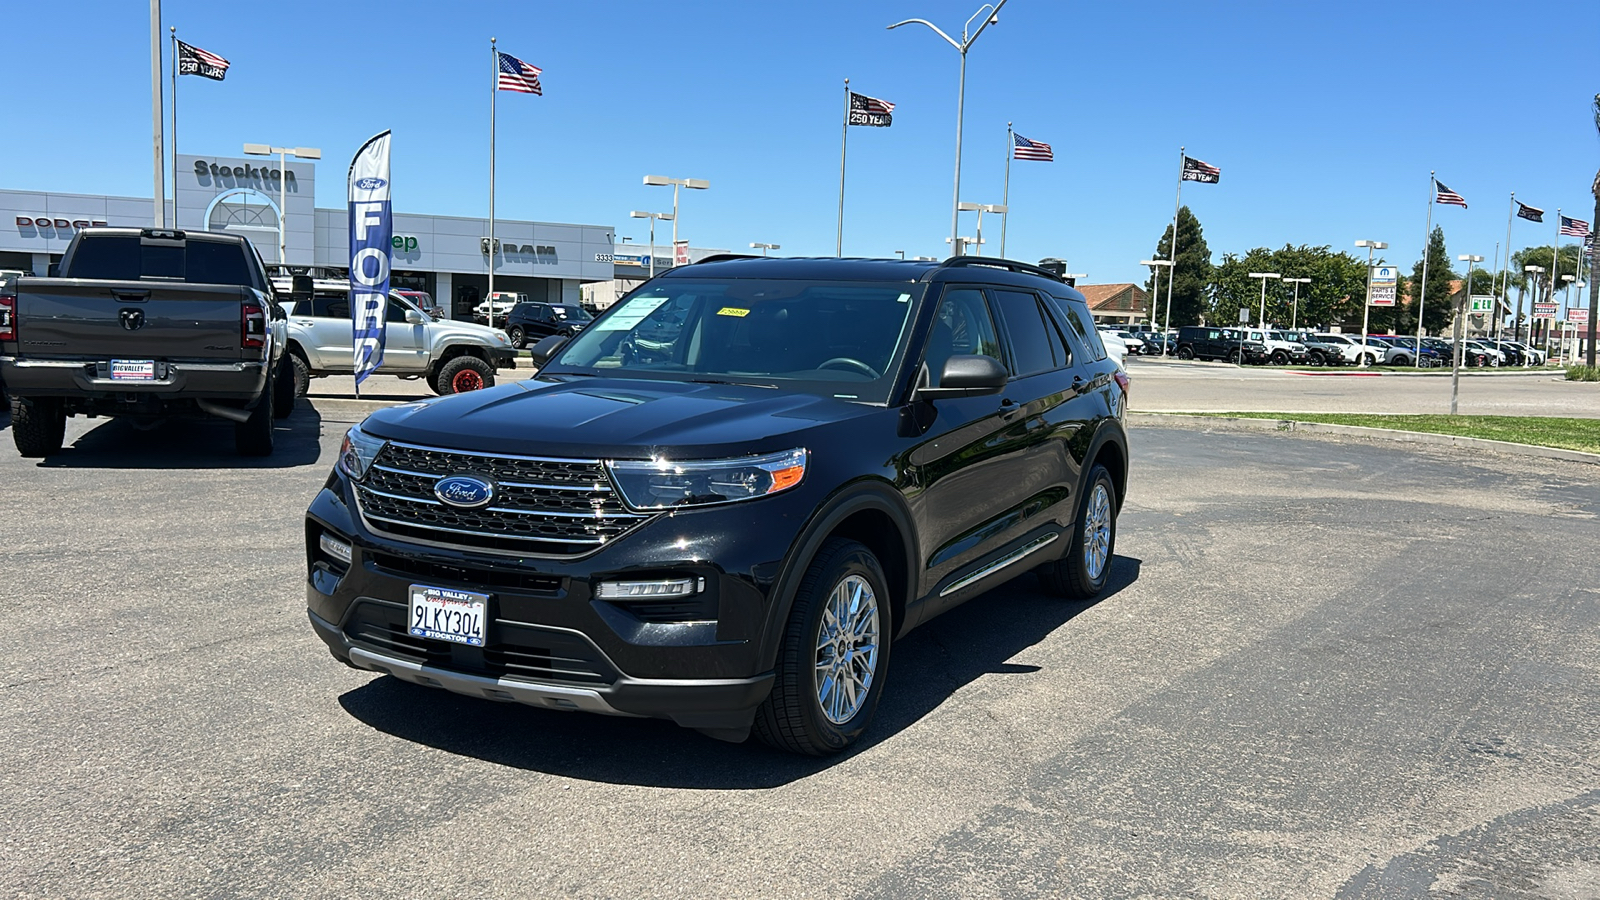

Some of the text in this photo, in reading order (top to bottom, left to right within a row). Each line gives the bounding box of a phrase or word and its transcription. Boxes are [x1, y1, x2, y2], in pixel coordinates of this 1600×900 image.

[181, 62, 225, 79] 250 YEARS
[851, 113, 868, 124] 250
[194, 160, 295, 180] Stockton
[1183, 172, 1197, 180] 250
[361, 179, 382, 189] Ford
[16, 216, 108, 228] DODGE
[391, 235, 418, 253] ep
[502, 243, 556, 256] RAM
[596, 253, 613, 262] 3333
[352, 203, 389, 374] FORD
[1482, 300, 1492, 309] EV
[446, 482, 478, 501] Ford
[442, 590, 468, 600] VALLEY
[415, 605, 481, 637] 9LKY304
[425, 630, 468, 643] STOCKTON
